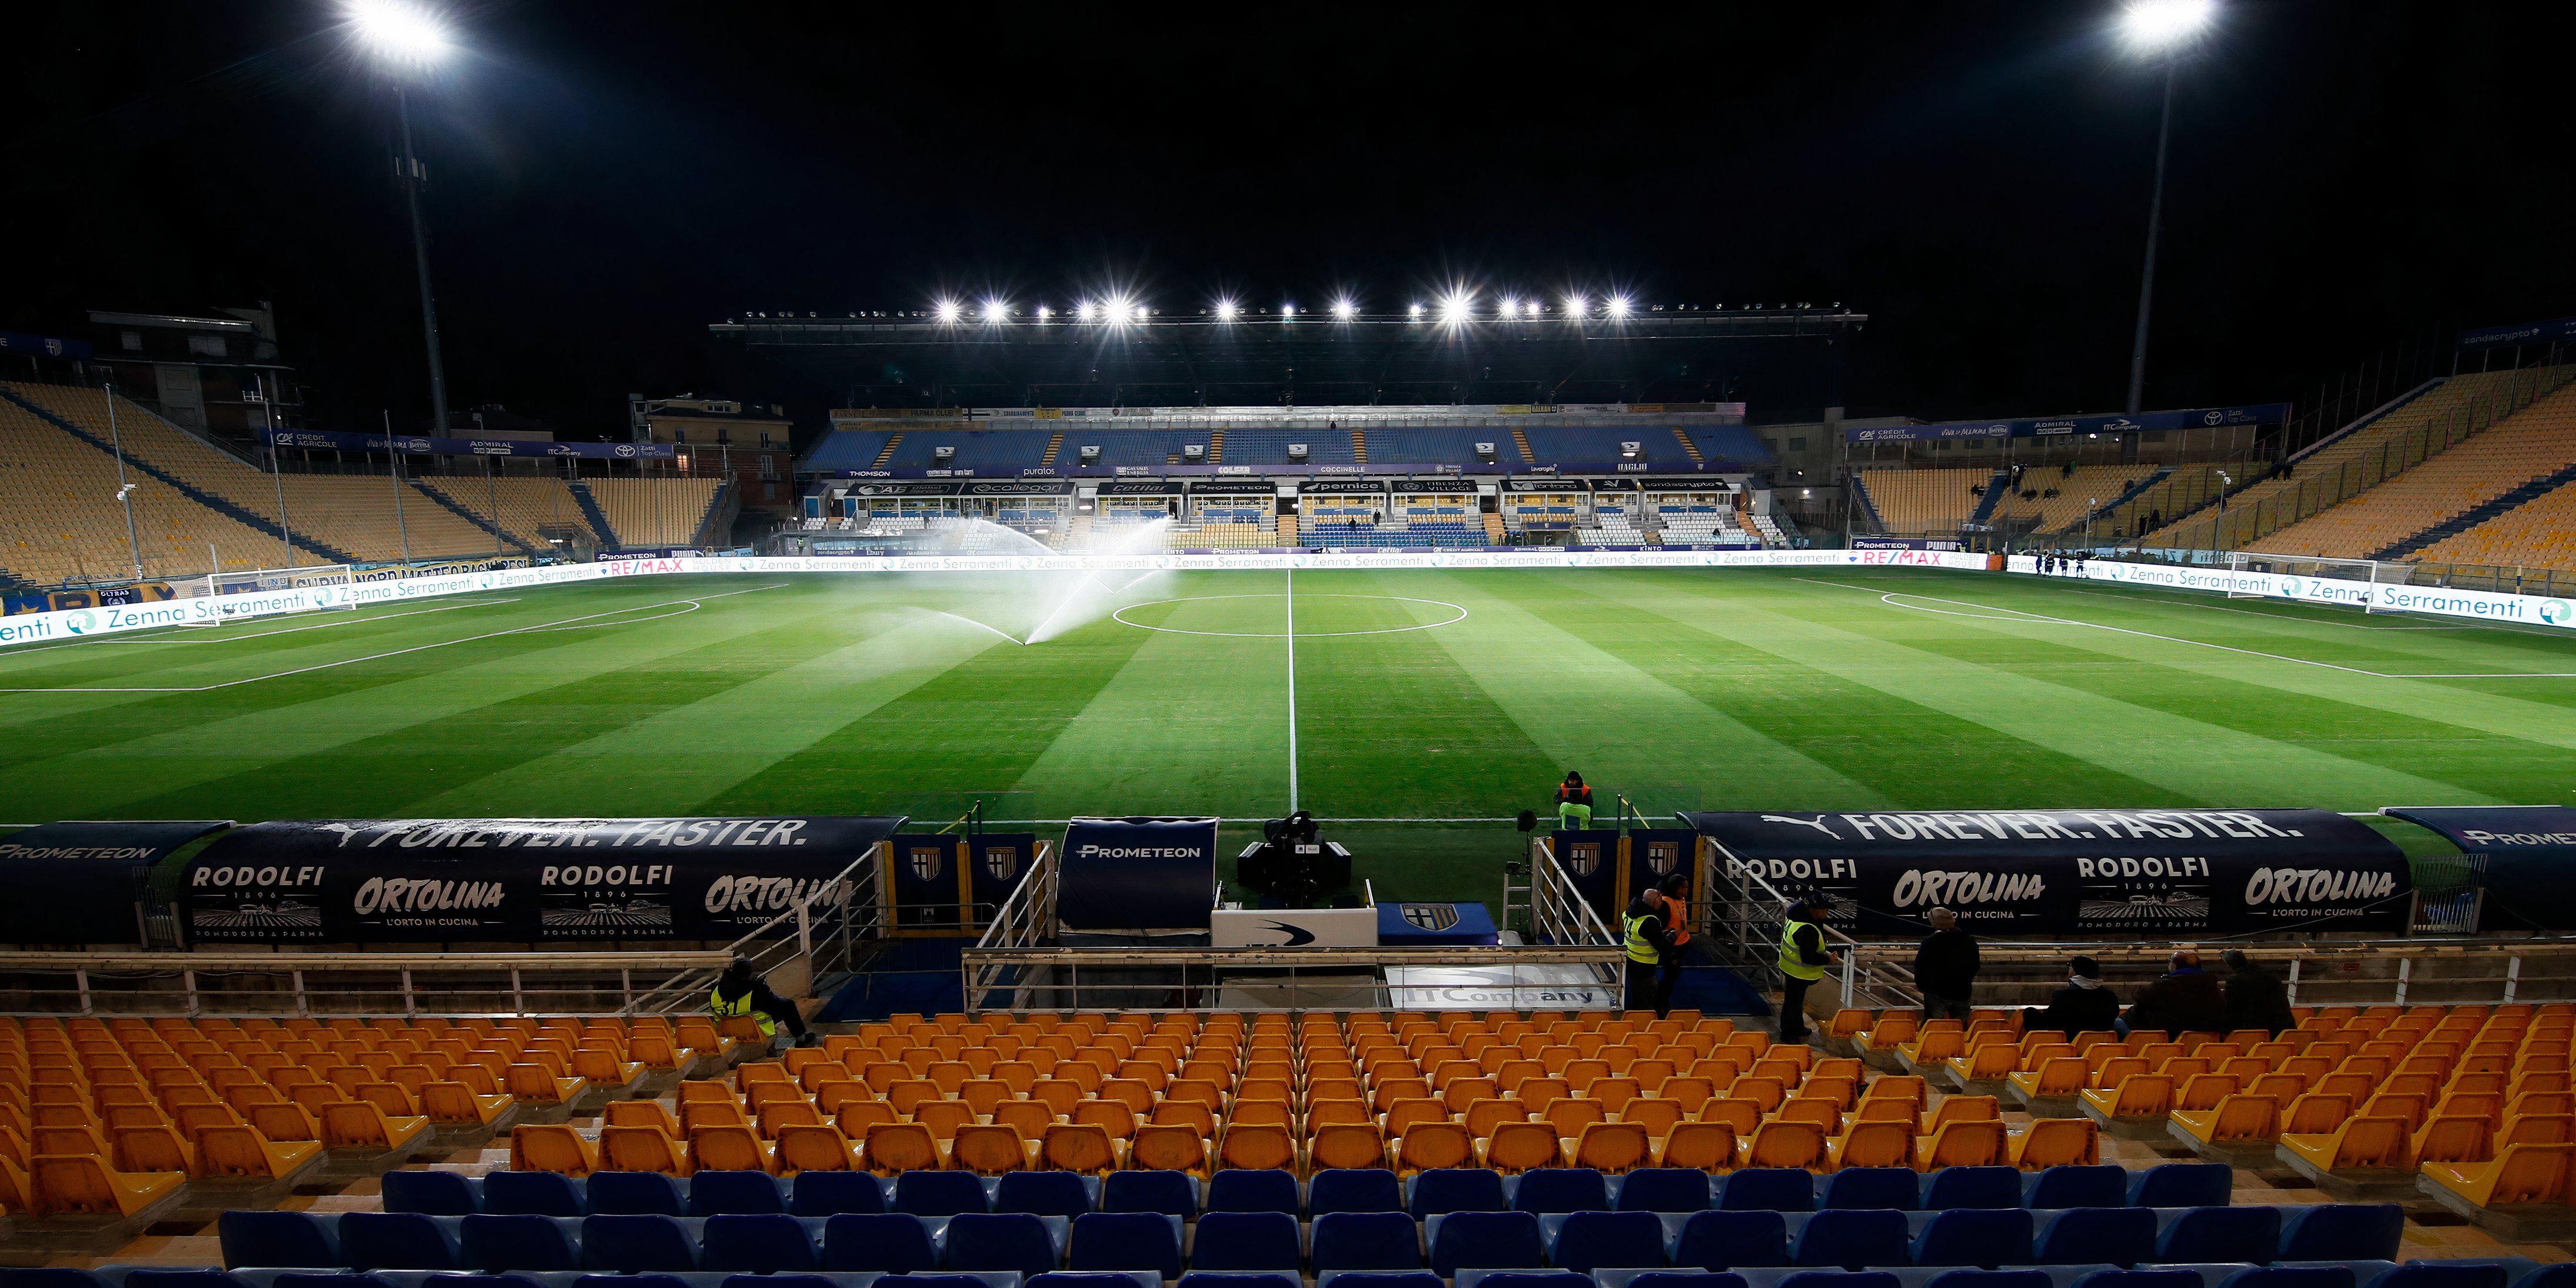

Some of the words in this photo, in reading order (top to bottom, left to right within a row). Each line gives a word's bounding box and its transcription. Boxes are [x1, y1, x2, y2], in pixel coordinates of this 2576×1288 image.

[2034, 421, 2077, 430] ADMIRAL
[1023, 467, 1055, 477] puratos
[1855, 541, 1910, 549] PROMETEON
[759, 559, 800, 570] Zenna
[805, 559, 875, 570] Serramenti
[900, 559, 939, 569] Zenna
[944, 558, 1012, 569] Serramenti
[1175, 557, 1213, 567] Zenna
[1218, 556, 1286, 567] Serramenti
[1312, 556, 1350, 566] Zenna
[1355, 555, 1423, 566] Serramenti
[1449, 555, 1488, 566] Zenna
[1493, 555, 1561, 566] Serramenti
[1586, 554, 1625, 565] Zenna
[1630, 553, 1699, 565] Serramenti
[1724, 553, 1763, 564] Zenna
[1769, 552, 1840, 564] Serramenti
[1864, 552, 1942, 566] RE/MAX
[1947, 560, 1978, 569] HOUSE
[611, 559, 684, 575] RE/MAX
[354, 570, 398, 583] NORD
[499, 573, 534, 586] Zenna
[539, 565, 595, 582] Serramenti
[2129, 566, 2173, 583] Zenna
[2179, 570, 2272, 592] Serramenti
[340, 586, 391, 601] Zenna
[397, 575, 474, 596] Serramenti
[2309, 581, 2374, 603] Zenna
[2384, 587, 2524, 618] Serramenti
[107, 608, 185, 629] Zenna
[195, 590, 305, 618] Serramenti
[0, 616, 51, 641] enti
[611, 820, 807, 847] FASTER.
[1839, 814, 2096, 840] FOREVER.
[2074, 813, 2305, 839] FASTER.
[0, 844, 158, 859] PROMETEON
[1076, 845, 1201, 858] PROMETEON
[541, 865, 673, 885] RODOLFI
[1725, 858, 1857, 879] RODOLFI
[2077, 857, 2209, 878] RODOLFI
[191, 866, 325, 887] RODOLFI
[1893, 869, 2046, 908] ORTOLINA
[2125, 883, 2168, 891] 1896
[2245, 867, 2396, 905] ORTOLINA
[354, 877, 505, 915] ORTOLINA
[386, 918, 423, 927] L'ORTO
[438, 918, 479, 927] CUCINA
[1961, 911, 1973, 919] IN
[1975, 911, 2015, 919] CUCINA
[1405, 988, 1593, 1004] ITCompany
